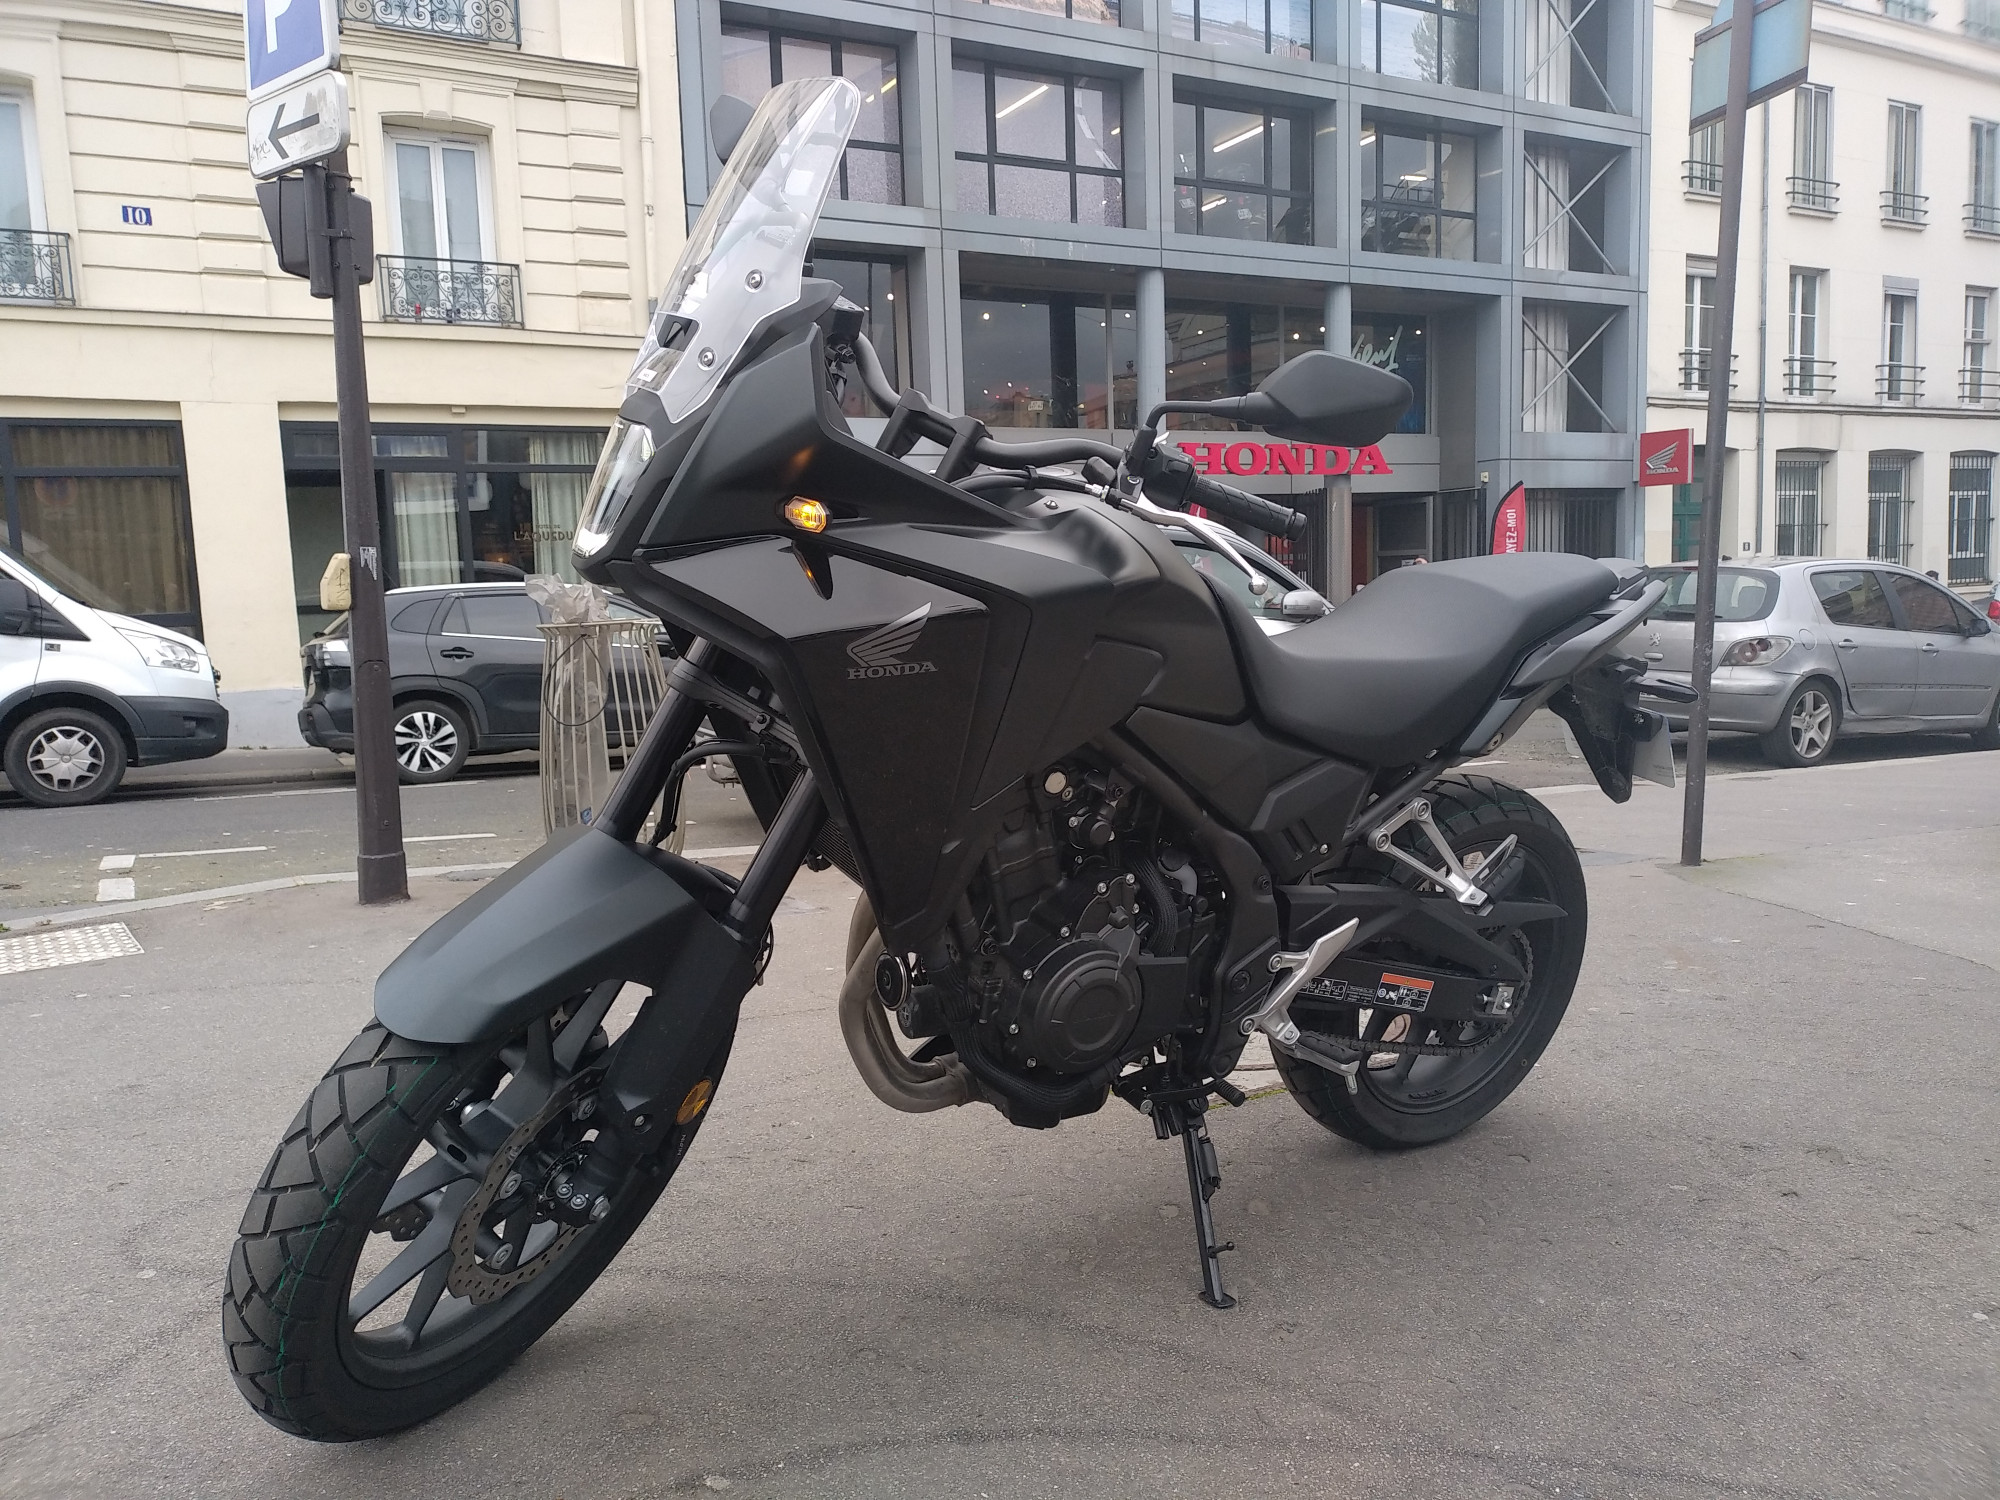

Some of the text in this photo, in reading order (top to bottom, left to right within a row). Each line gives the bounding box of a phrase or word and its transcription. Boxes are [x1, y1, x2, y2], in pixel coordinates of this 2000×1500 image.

[127, 207, 147, 225] 10
[1177, 442, 1393, 476] HONDA
[847, 661, 938, 680] HONDA
